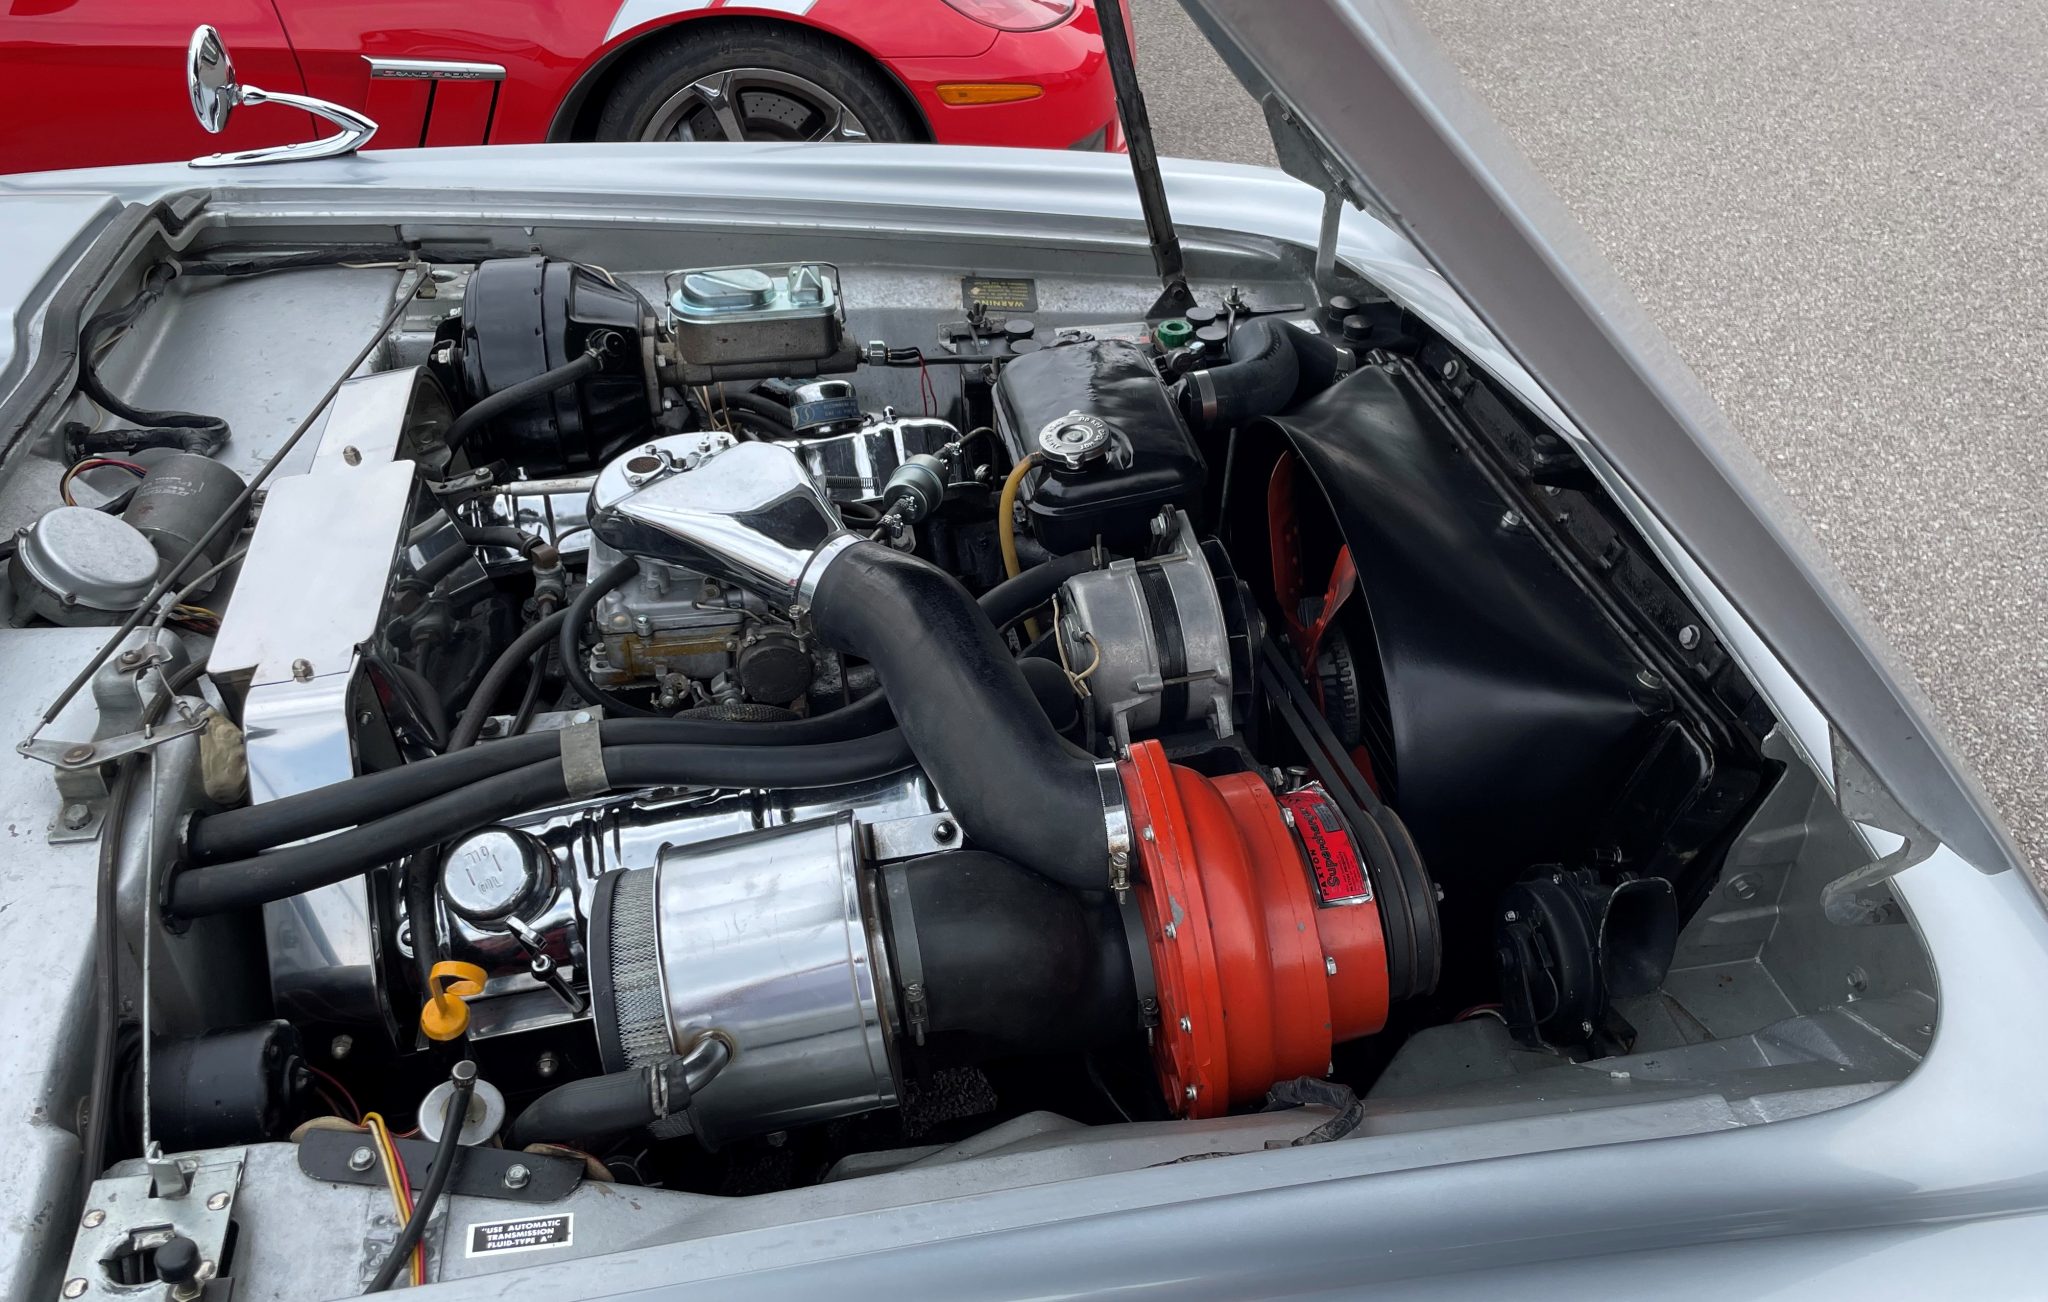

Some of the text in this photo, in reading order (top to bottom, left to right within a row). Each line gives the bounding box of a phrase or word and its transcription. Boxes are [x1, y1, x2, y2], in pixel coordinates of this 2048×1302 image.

[1310, 849, 1329, 896] PAXTON
[507, 1219, 561, 1232] AUTOMATIC
[487, 1227, 555, 1241] TRANSMISSION
[487, 1237, 536, 1249] FLUID-TYPE
